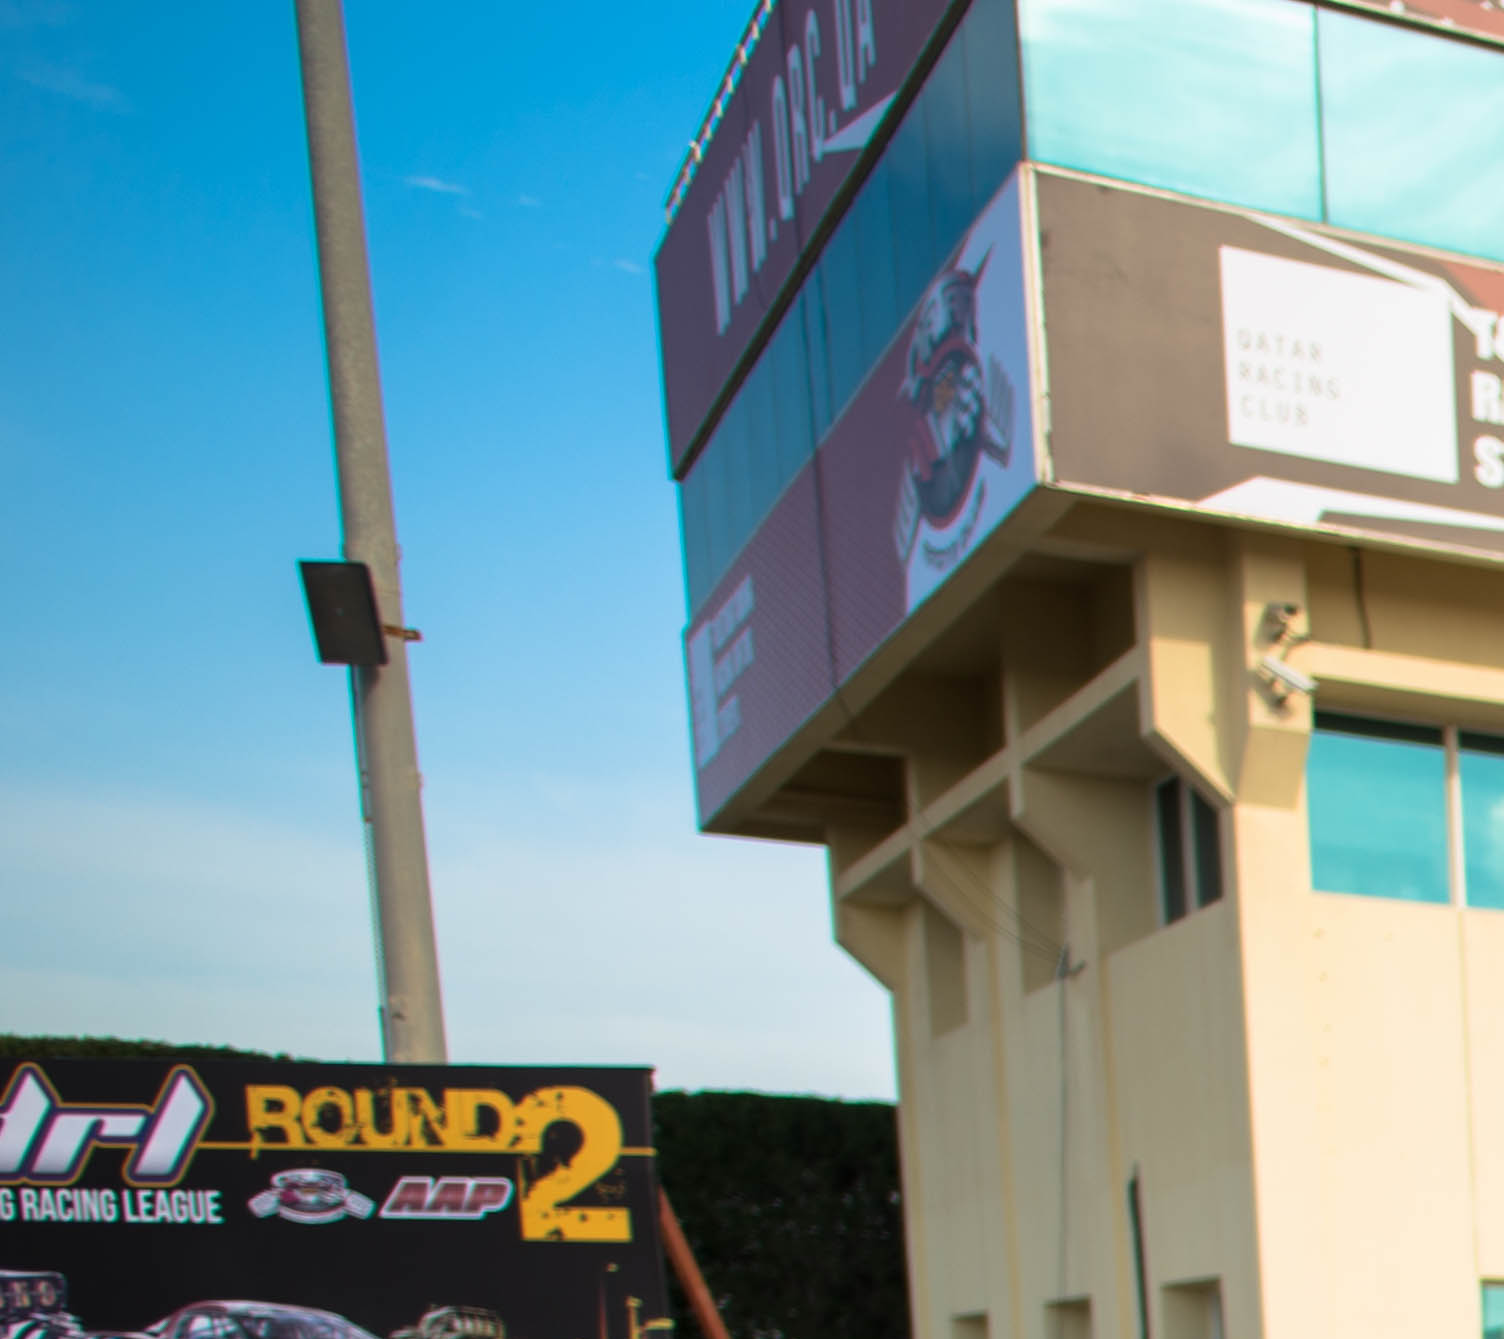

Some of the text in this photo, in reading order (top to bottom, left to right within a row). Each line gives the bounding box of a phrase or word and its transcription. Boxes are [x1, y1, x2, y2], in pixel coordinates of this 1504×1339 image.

[1236, 328, 1324, 365] QATAR
[1238, 360, 1342, 402] RACING
[1240, 393, 1311, 428] CLUB
[245, 1084, 632, 1242] ROUND 2
[19, 1188, 118, 1223] RACING
[122, 1189, 226, 1225] LEAGUE
[378, 1175, 514, 1221] AAP
